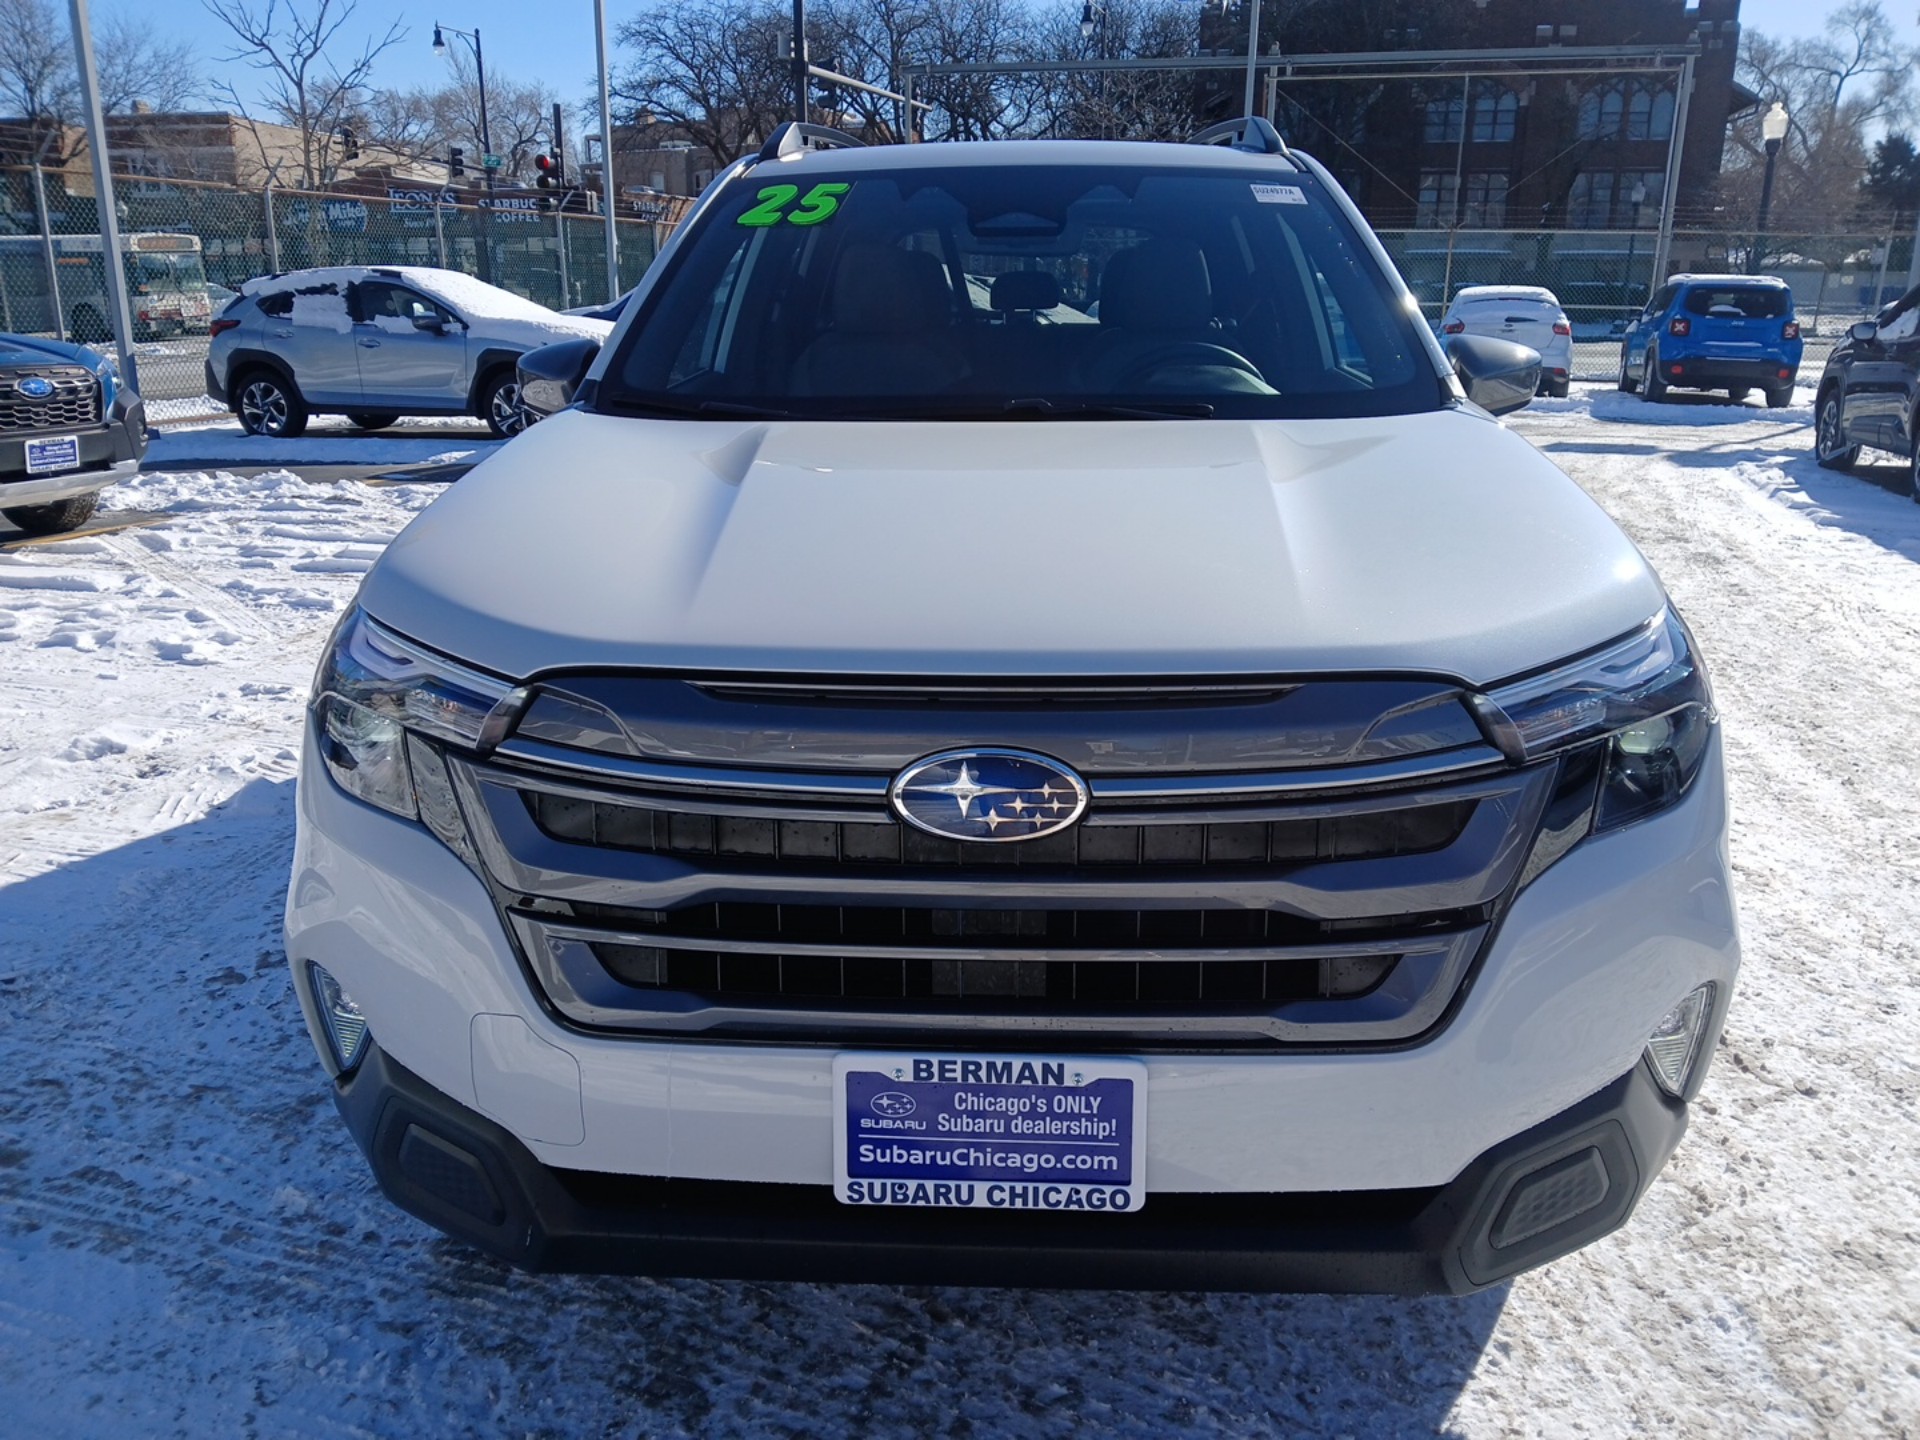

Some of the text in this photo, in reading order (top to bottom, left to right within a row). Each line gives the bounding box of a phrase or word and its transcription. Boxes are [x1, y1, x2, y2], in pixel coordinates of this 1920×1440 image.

[495, 211, 540, 222] COFFEE
[737, 183, 851, 226] 25
[912, 1058, 1065, 1086] BERMAN
[954, 1092, 1102, 1116] Chicago's ONLY
[860, 1118, 927, 1130] SUBARU
[937, 1113, 1117, 1139] Subaru dealership!
[858, 1144, 1118, 1173] SubaruChicago.com
[846, 1181, 1131, 1211] SUBARU CHICAGO
